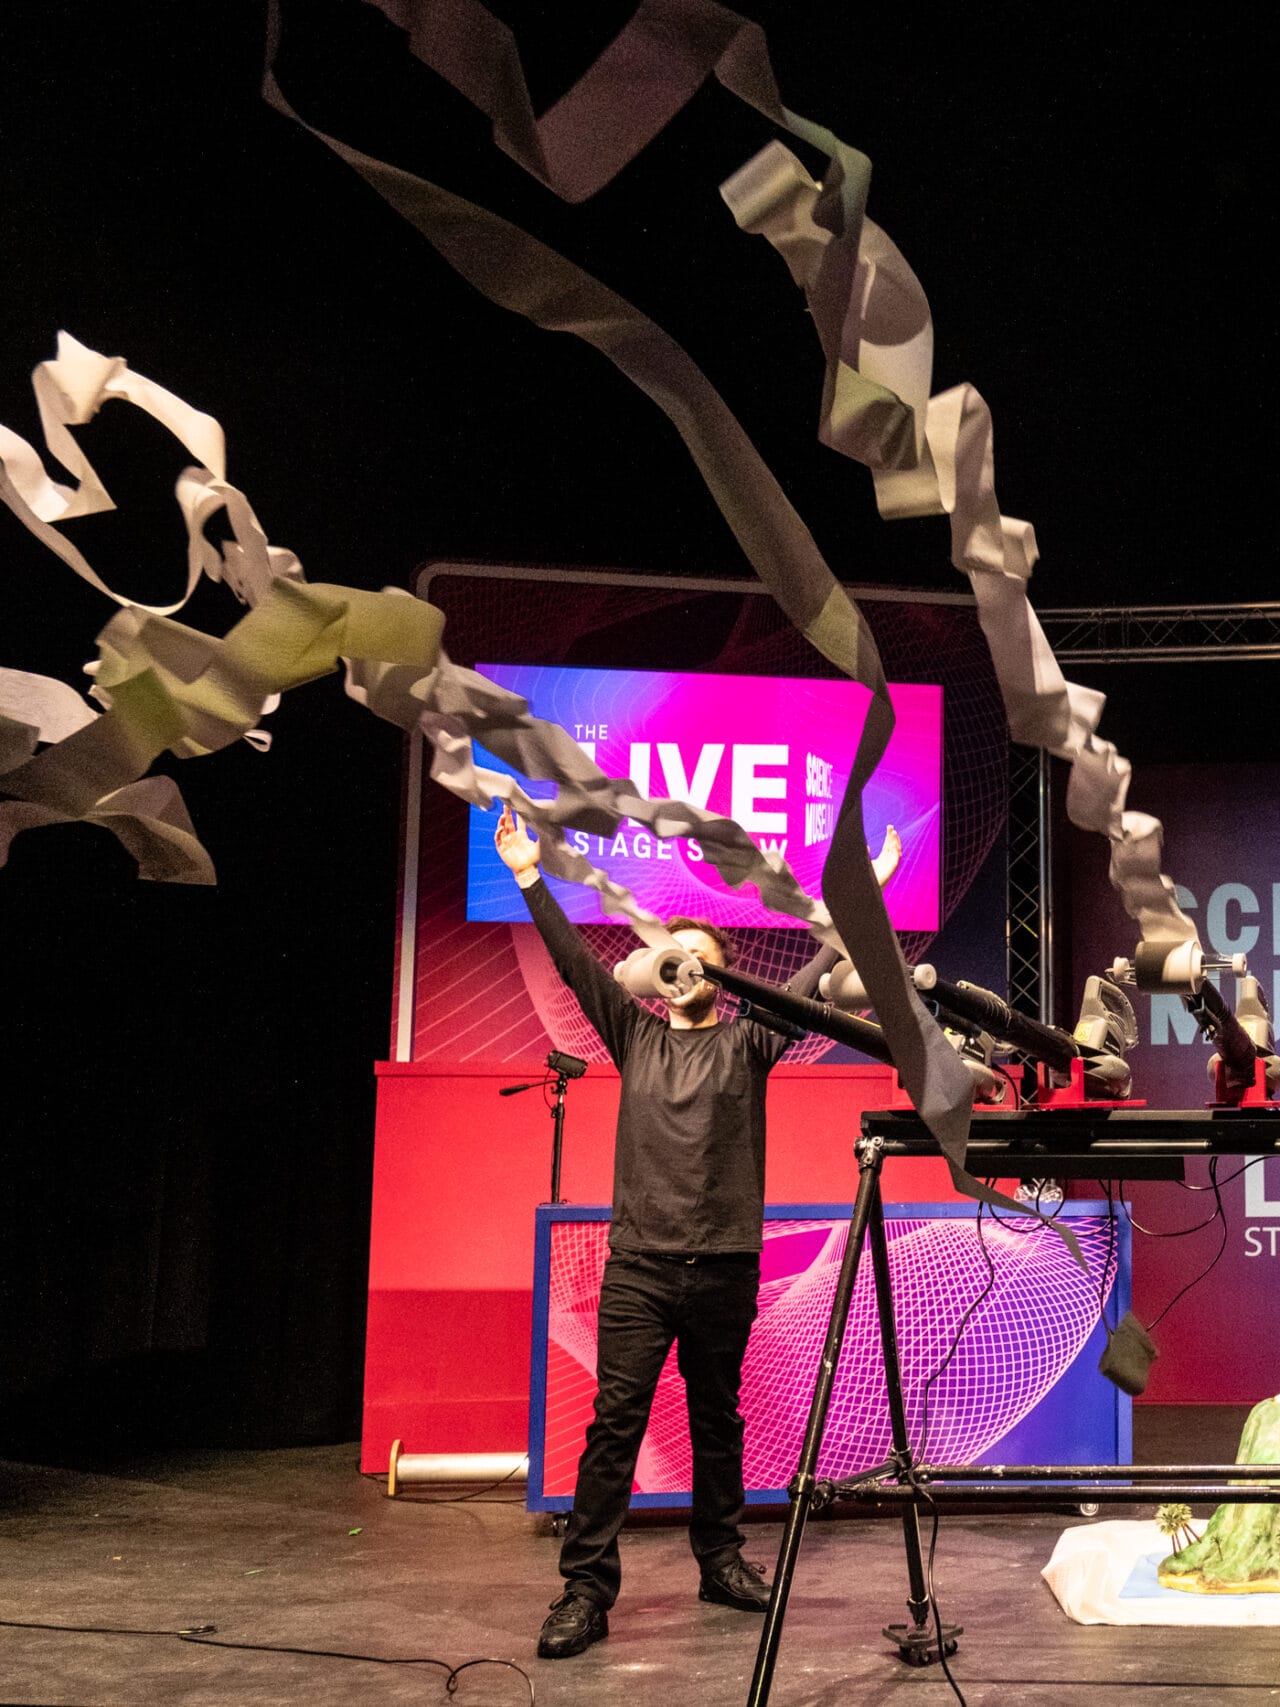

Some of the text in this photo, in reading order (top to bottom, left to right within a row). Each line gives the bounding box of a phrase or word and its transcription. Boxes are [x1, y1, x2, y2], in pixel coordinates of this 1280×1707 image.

[574, 724, 608, 740] THE
[577, 742, 789, 834] IVE
[686, 838, 788, 862] SW
